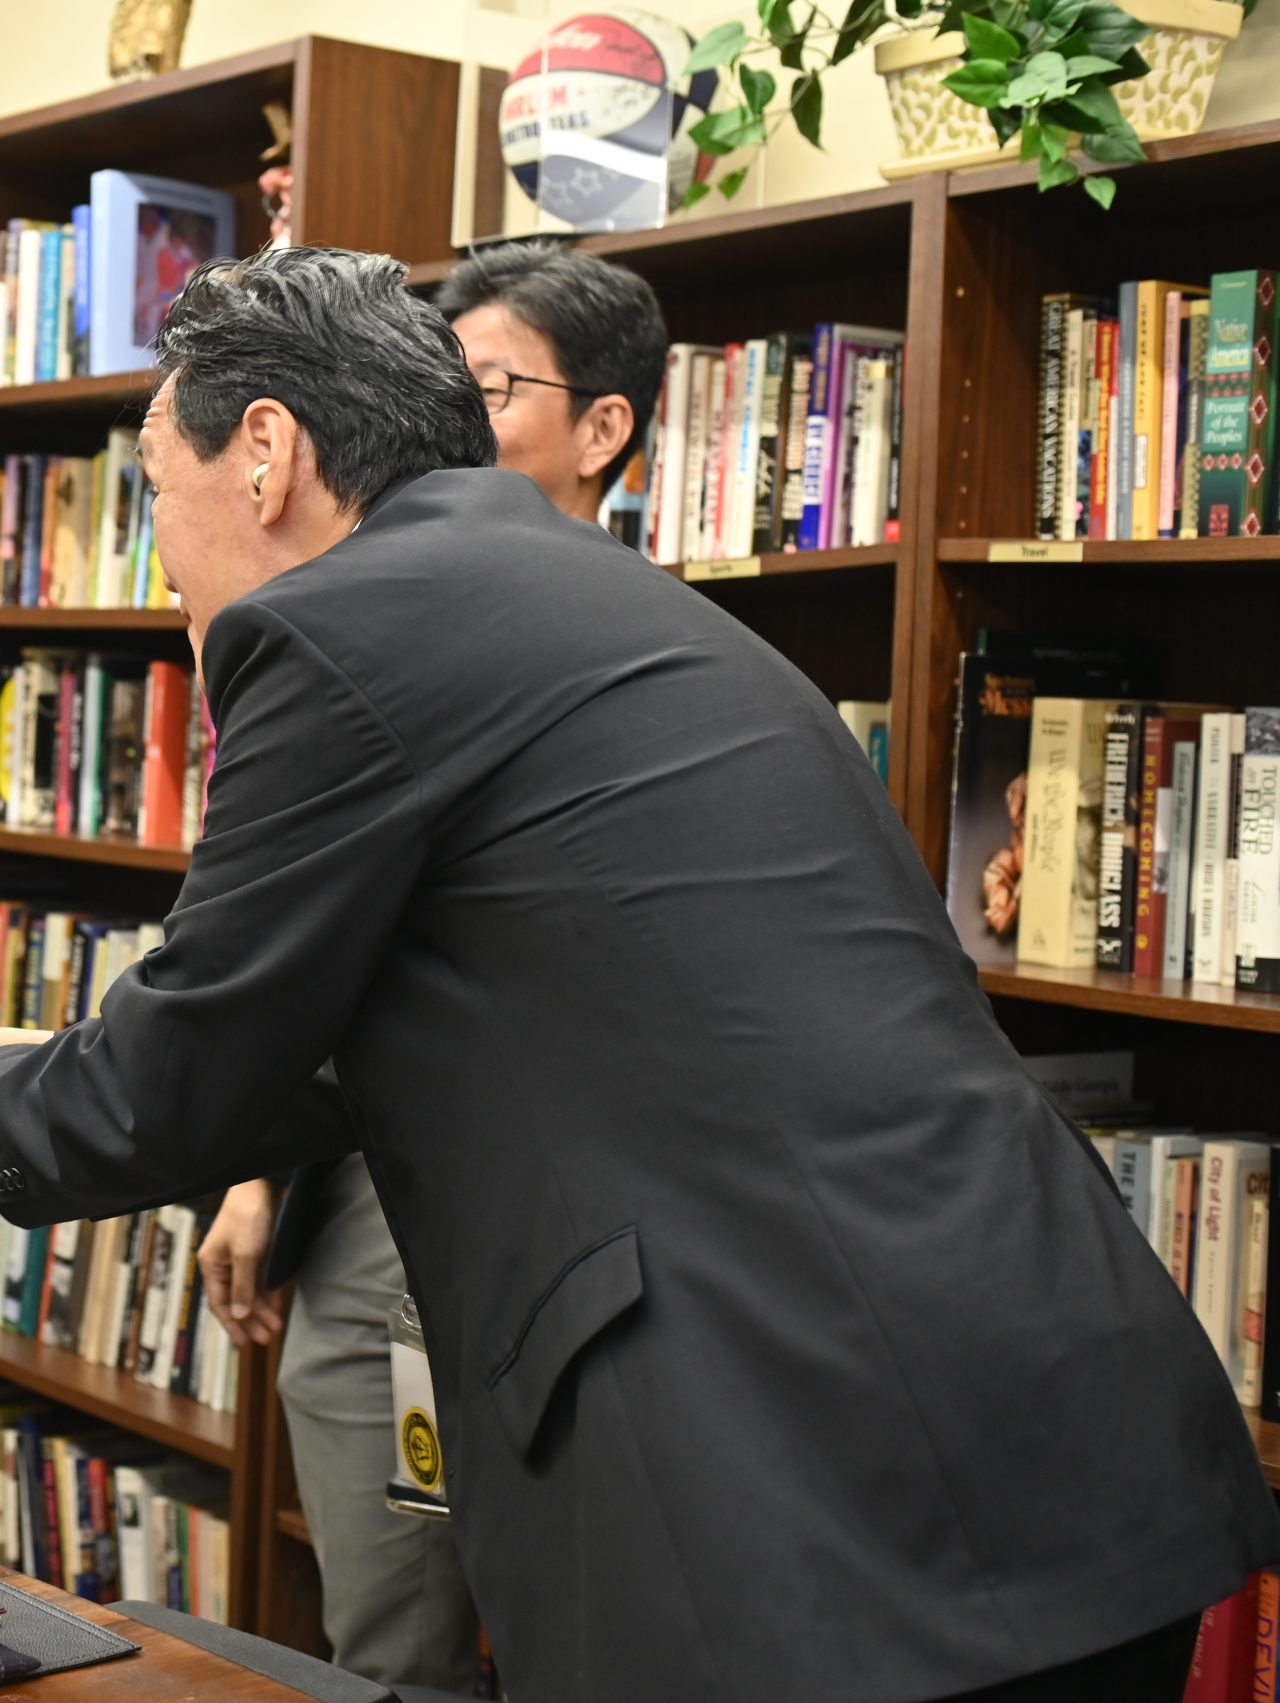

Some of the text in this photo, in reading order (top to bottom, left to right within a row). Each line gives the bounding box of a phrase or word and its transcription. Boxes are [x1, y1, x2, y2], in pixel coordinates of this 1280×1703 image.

[1215, 318, 1248, 342] Native
[1040, 302, 1063, 519] GREAT AMERICAN VACATIONS
[1206, 399, 1245, 415] Portrait
[1210, 413, 1239, 430] of the
[809, 423, 824, 439] BY
[1206, 426, 1242, 445] Peoples
[804, 446, 824, 498] GEORGE
[1021, 545, 1049, 558] Travel
[1099, 731, 1130, 930] FREDERICK DOUGLASS
[1240, 787, 1261, 856] FIRE
[1258, 765, 1278, 857] TOUCHED
[1136, 753, 1157, 917] HOMECOMING
[1120, 1152, 1138, 1186] THE
[1204, 1156, 1224, 1242] City of Light
